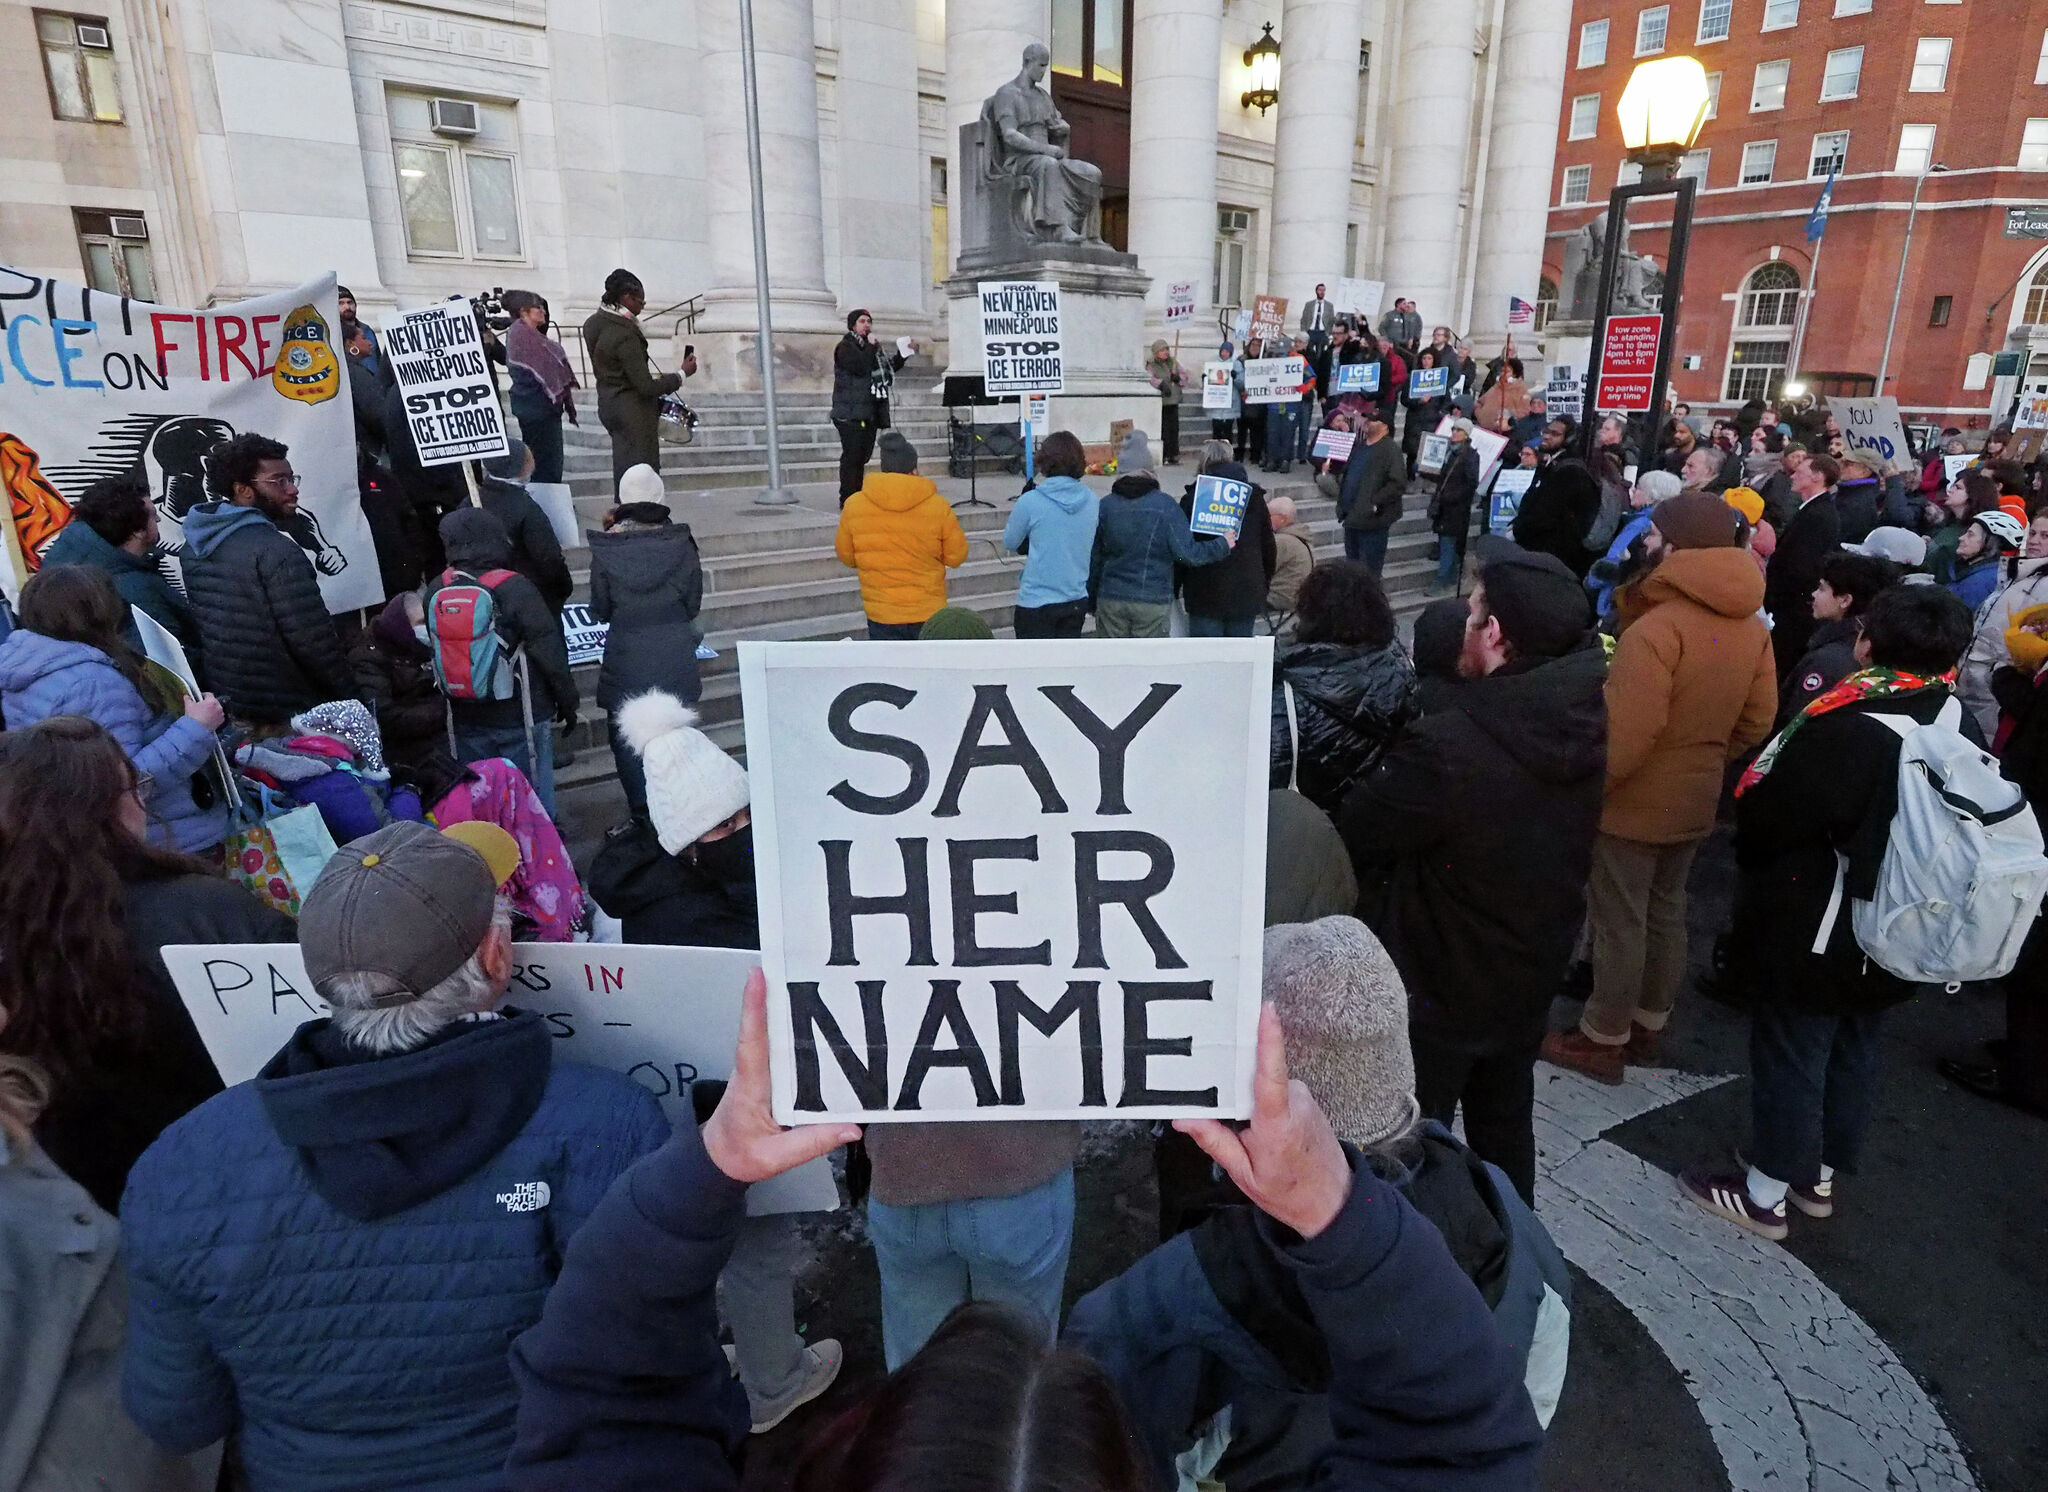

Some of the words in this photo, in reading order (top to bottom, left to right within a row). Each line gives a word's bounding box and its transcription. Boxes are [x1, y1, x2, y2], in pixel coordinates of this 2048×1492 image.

[2008, 220, 2024, 229] For
[983, 292, 1013, 313] NEW
[1016, 291, 1057, 312] HAVEN
[1258, 300, 1276, 313] ICE
[405, 310, 446, 325] FROM
[287, 326, 318, 340] ICE
[984, 317, 1058, 336] MINNEAPOLIS
[386, 323, 423, 357] NEW
[422, 315, 476, 349] HAVEN
[0, 314, 104, 389] CE
[103, 352, 168, 391] ON
[150, 313, 281, 382] FIRE
[986, 341, 1060, 357] STOP
[1637, 341, 1655, 349] 9am
[425, 348, 445, 359] TO
[1606, 350, 1624, 358] 4pm
[1635, 350, 1654, 358] 6pm
[396, 350, 485, 387] MINNEAPOLIS
[988, 359, 1009, 380] ICE
[1011, 357, 1061, 379] TERROR
[1284, 364, 1303, 375] ICE
[1348, 365, 1373, 377] ICE
[1420, 370, 1441, 382] ICE
[1616, 385, 1647, 393] parking
[406, 384, 491, 415] STOP
[1848, 407, 1874, 425] YOU
[411, 416, 440, 445] ICE
[436, 407, 500, 441] TERROR
[1893, 421, 1899, 432] ?
[469, 442, 477, 453] &
[1213, 481, 1249, 507] ICE
[1209, 503, 1236, 515] OUT
[826, 681, 1183, 817] SAY
[818, 829, 1189, 970] HER
[584, 963, 624, 994] IN
[787, 979, 1219, 1112] NAME
[514, 1182, 537, 1193] THE
[496, 1192, 536, 1204] NORTH
[507, 1201, 536, 1213] FACE
